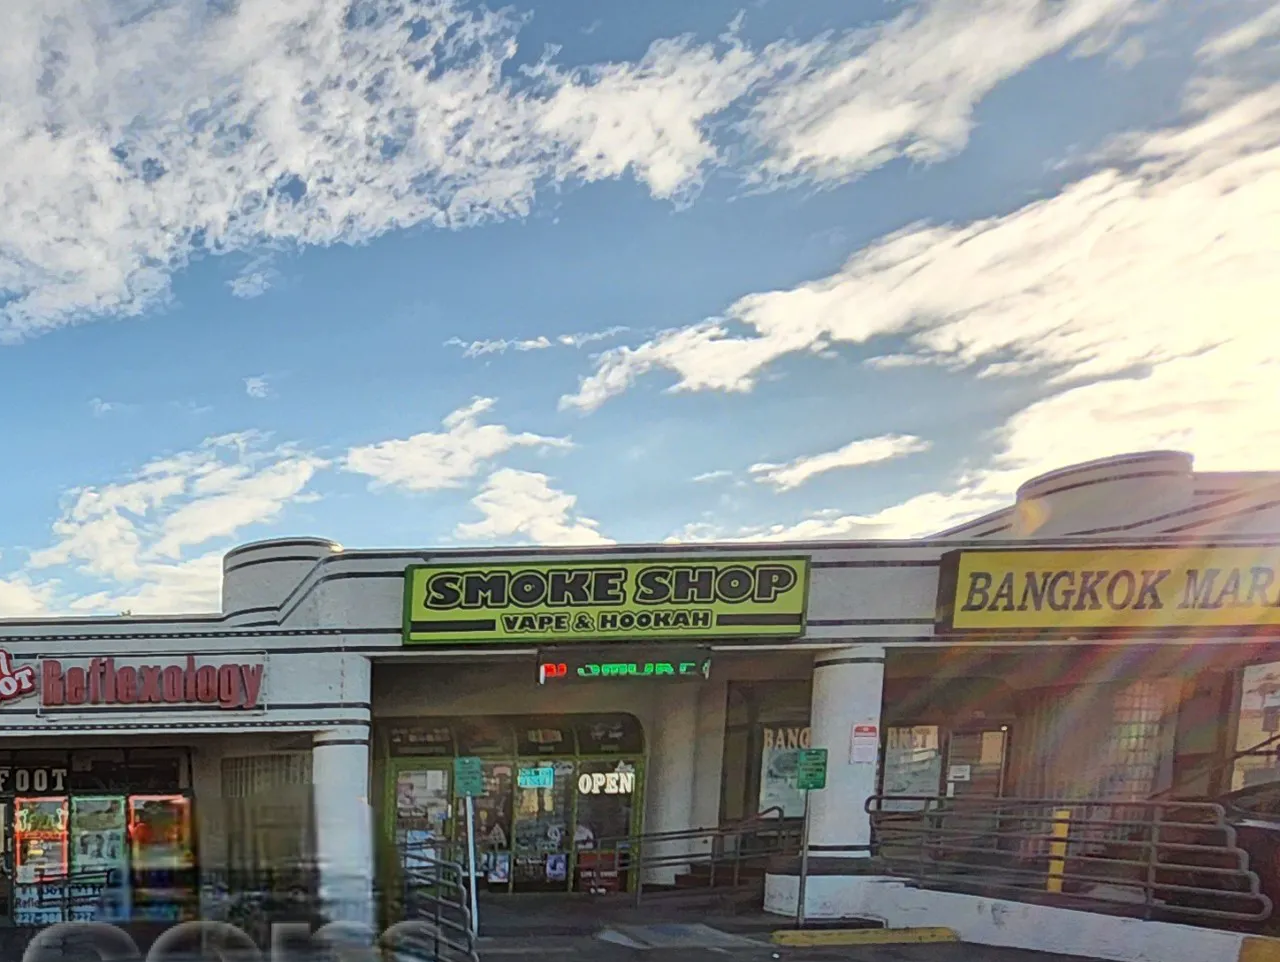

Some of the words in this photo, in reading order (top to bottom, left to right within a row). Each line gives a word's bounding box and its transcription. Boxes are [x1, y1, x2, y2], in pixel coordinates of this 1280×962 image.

[423, 567, 627, 609] SMOKE
[632, 564, 798, 604] SHOP
[960, 568, 1171, 612] BANGKOK
[1176, 566, 1280, 609] MAR
[501, 613, 570, 634] VAPE
[574, 612, 597, 631] &
[598, 608, 713, 631] HOOKAH
[41, 655, 265, 710] Reflexology
[577, 771, 636, 796] OPEN
